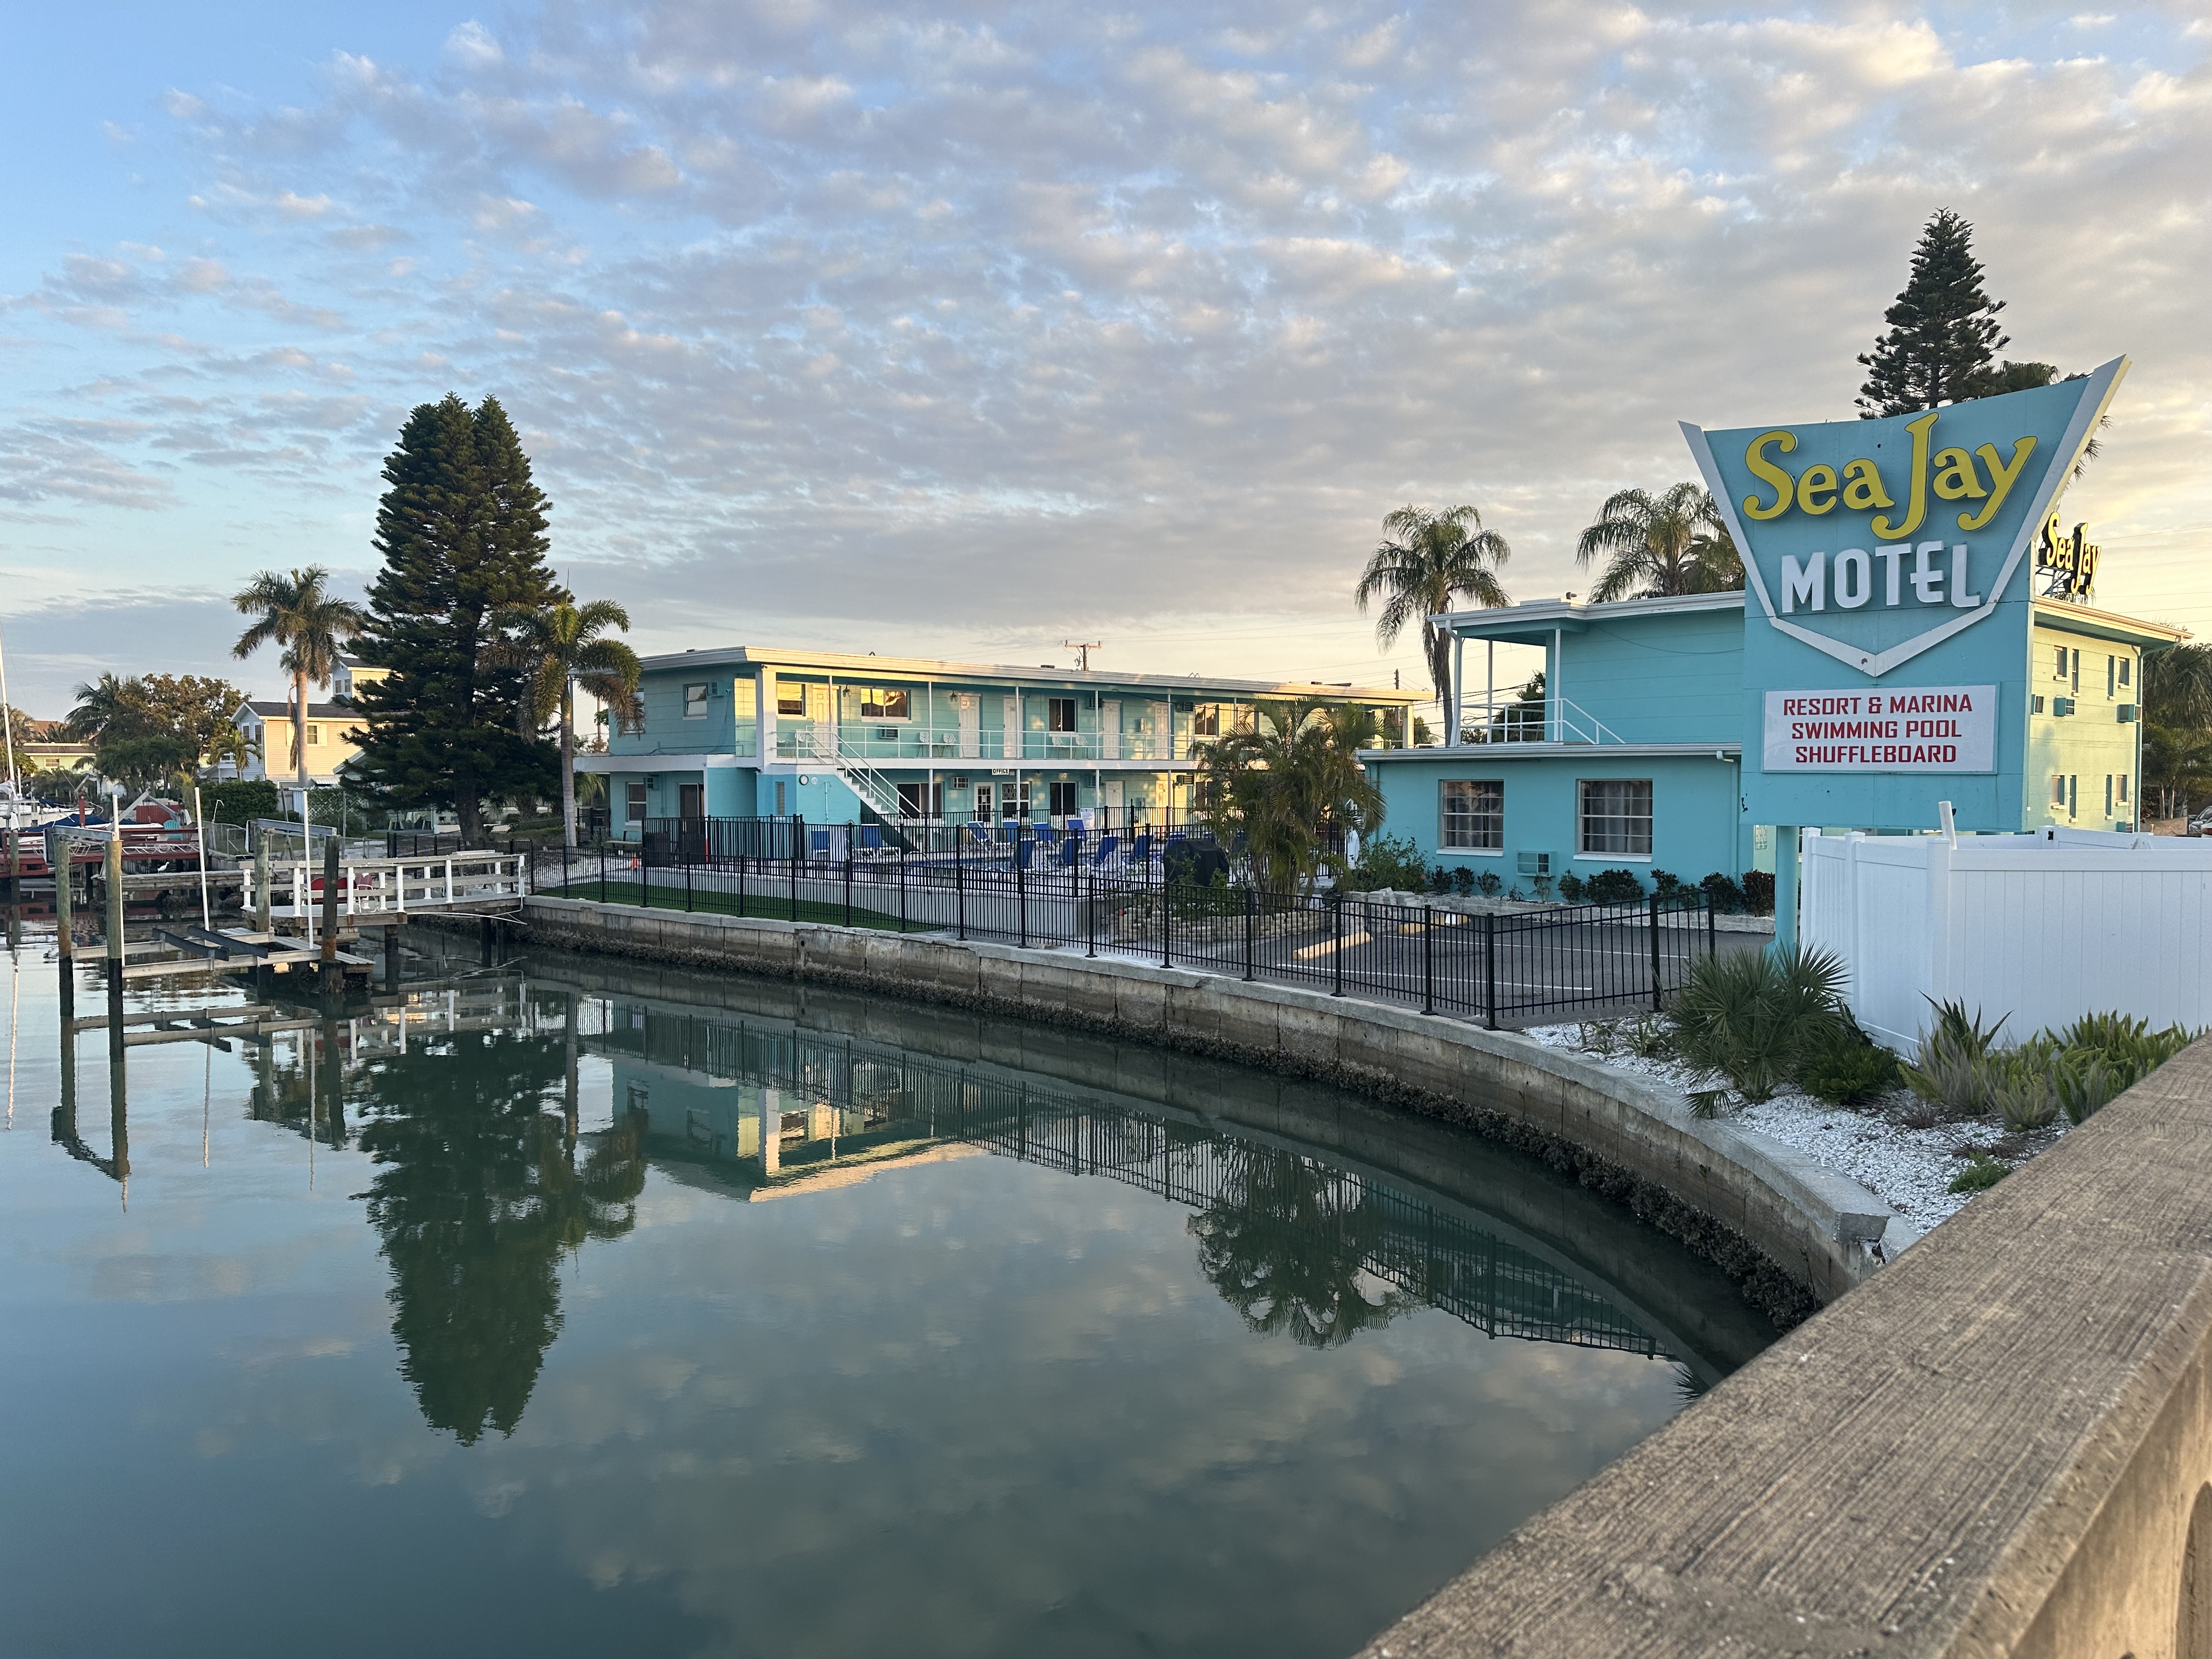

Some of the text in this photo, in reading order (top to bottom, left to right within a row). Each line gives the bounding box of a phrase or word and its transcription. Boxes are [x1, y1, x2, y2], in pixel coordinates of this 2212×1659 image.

[1742, 412, 2039, 540] Sea Jay
[1781, 540, 1981, 613] MOTEL
[2045, 511, 2102, 596] Sea Jay
[1784, 694, 1973, 715] RESORT & MARINA
[1792, 720, 1962, 739] SWIMMING POOL
[1796, 744, 1956, 763] SHUFFLEBOARD
